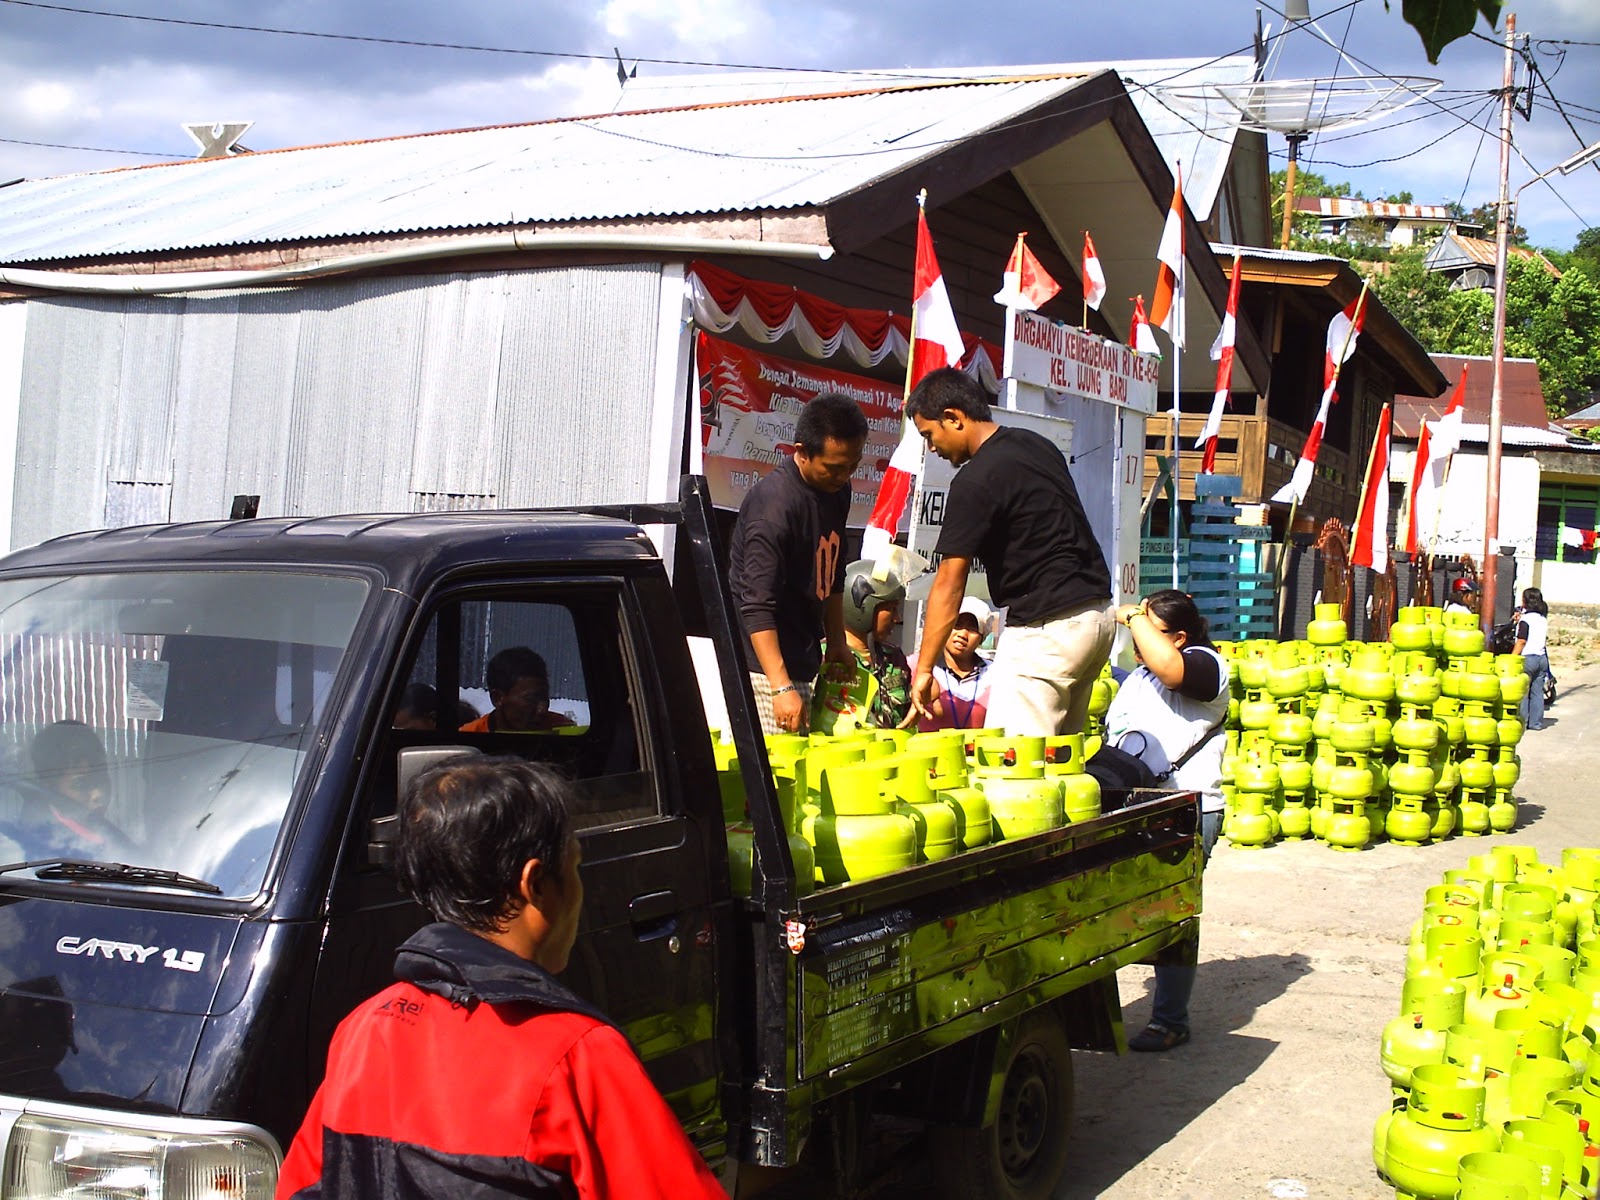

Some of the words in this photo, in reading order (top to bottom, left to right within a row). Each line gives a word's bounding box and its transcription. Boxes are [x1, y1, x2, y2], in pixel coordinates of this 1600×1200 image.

[1014, 313, 1063, 355] DIRGAHAYU
[1065, 331, 1118, 373] KEMERDEKAAN
[1122, 351, 1130, 376] RI
[759, 363, 790, 387] Dengan
[791, 370, 831, 396] Semangat
[875, 390, 884, 406] 17
[1050, 357, 1071, 387] KEL.
[1077, 364, 1101, 395] UJUNG
[1109, 374, 1127, 402] BARU
[730, 470, 750, 491] yang
[1125, 455, 1138, 485] 17
[1122, 563, 1136, 595] 08
[56, 935, 159, 964] CARRY
